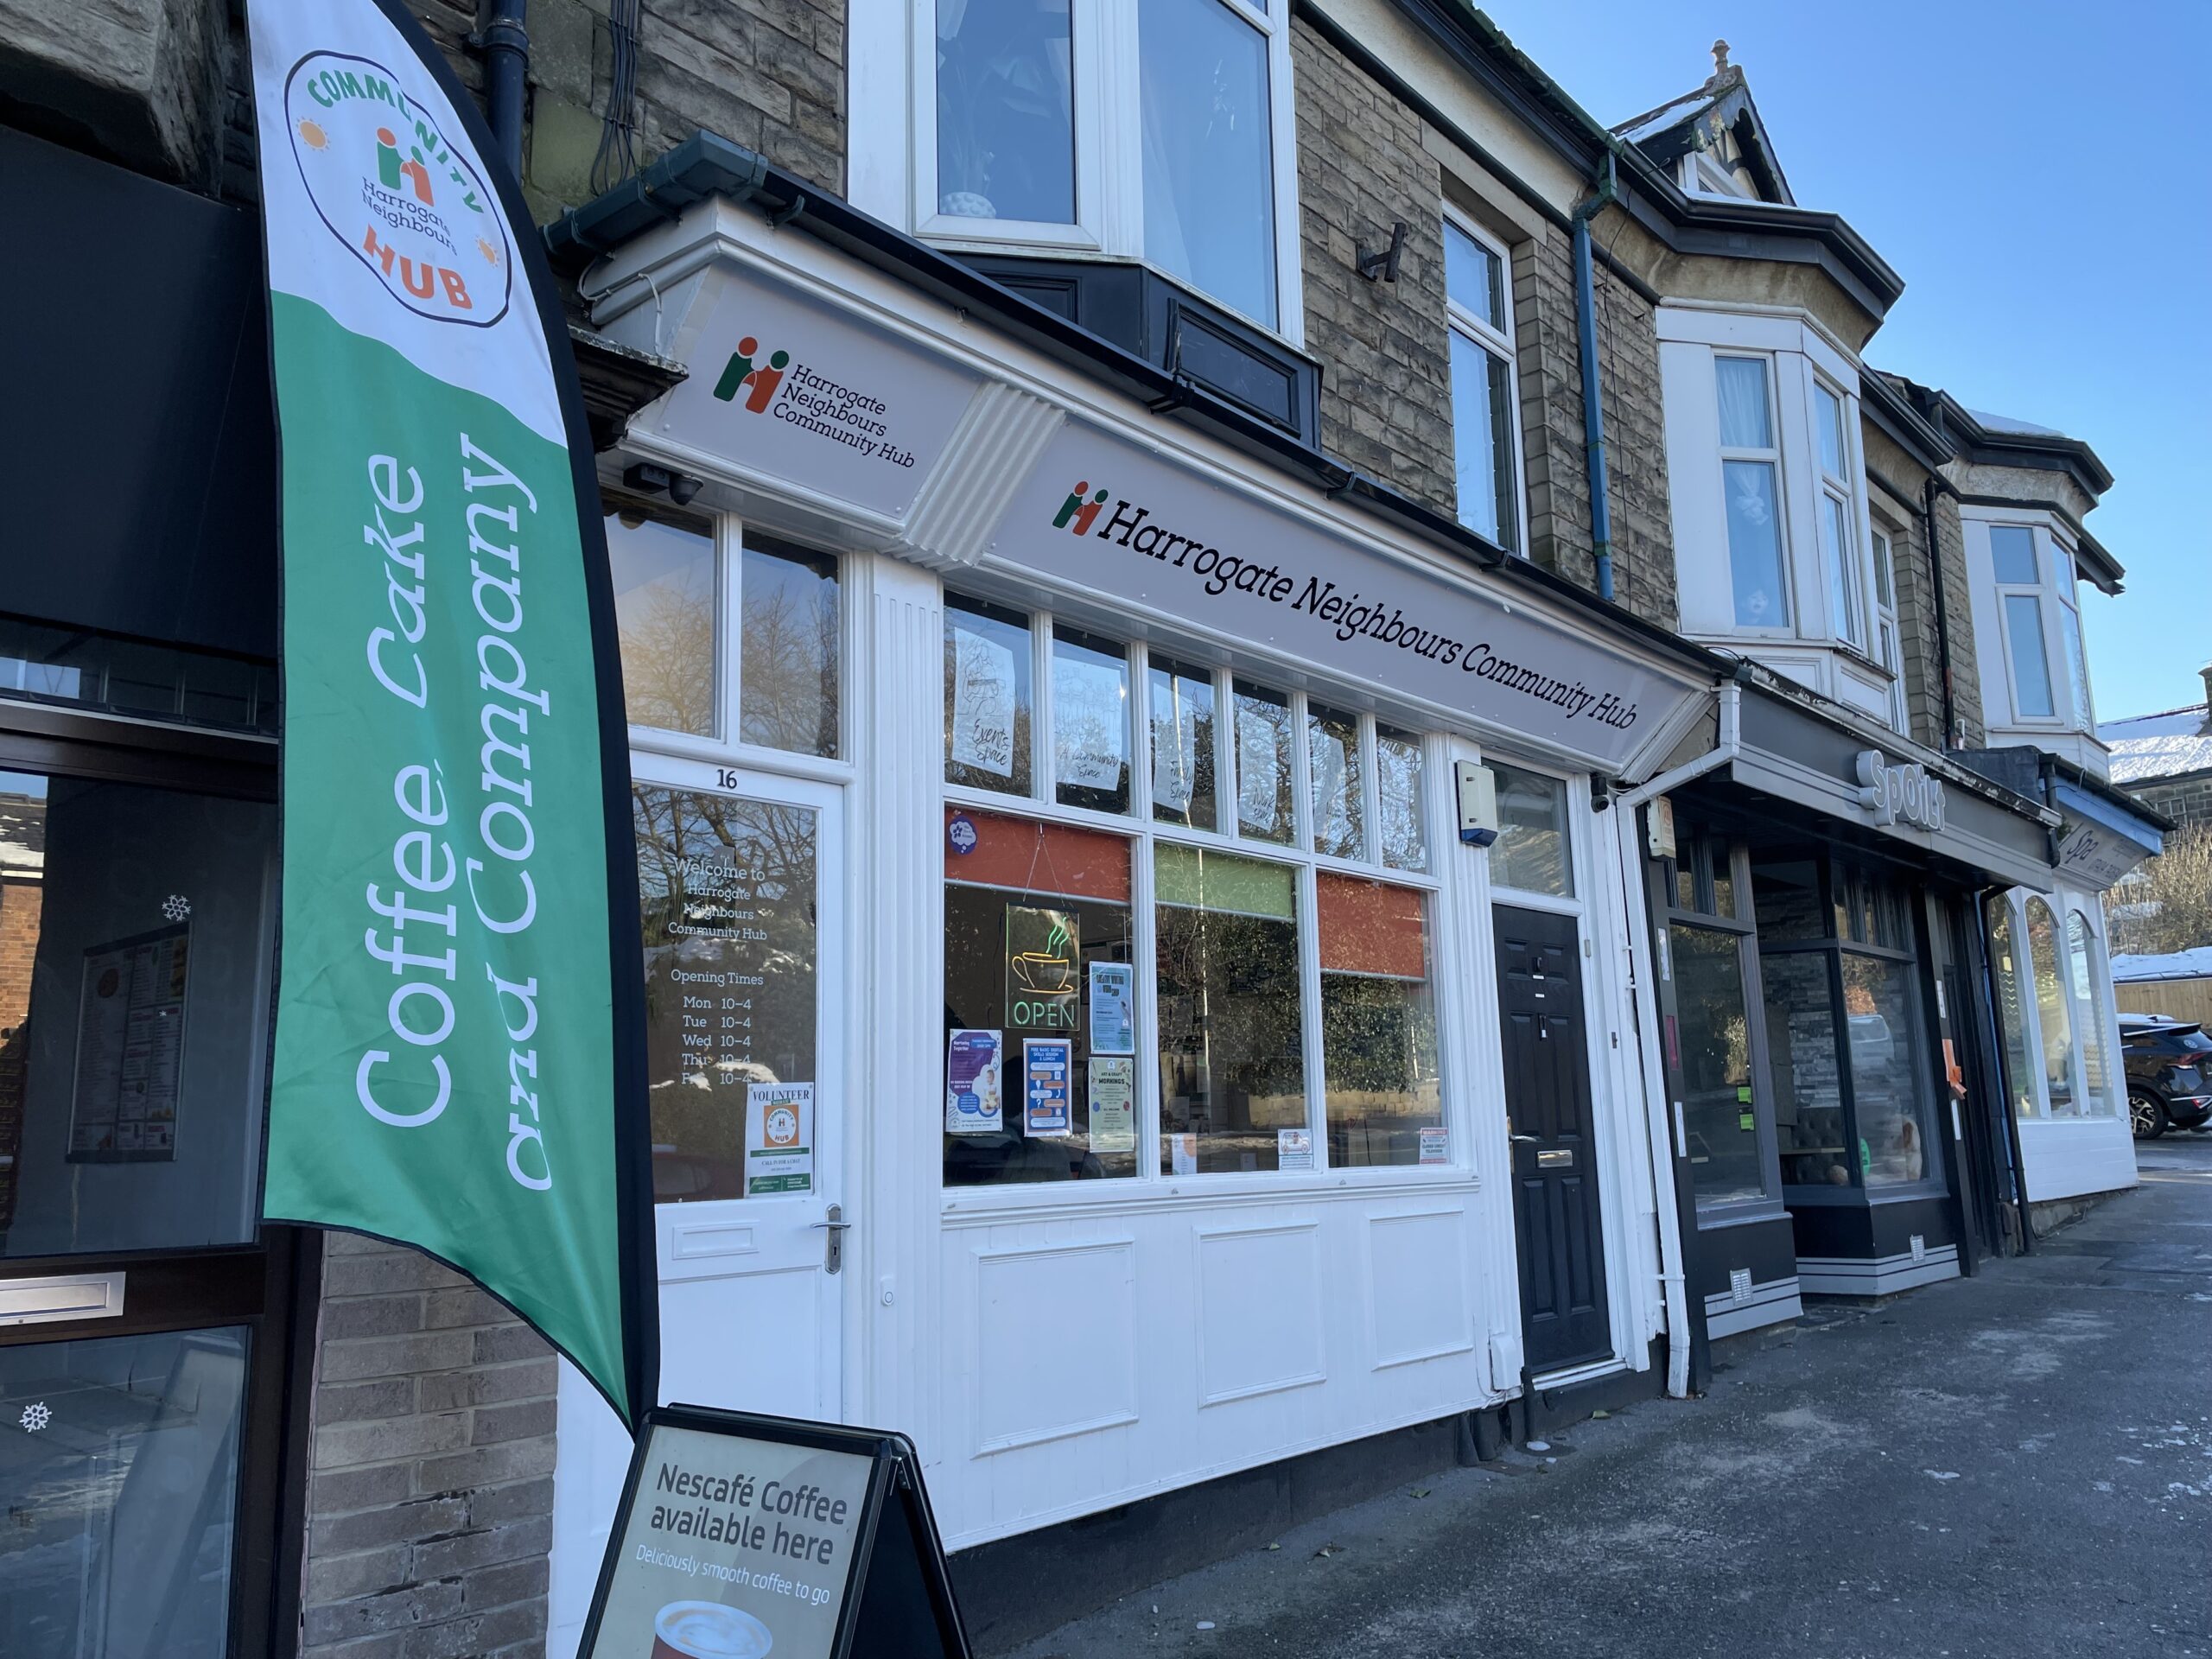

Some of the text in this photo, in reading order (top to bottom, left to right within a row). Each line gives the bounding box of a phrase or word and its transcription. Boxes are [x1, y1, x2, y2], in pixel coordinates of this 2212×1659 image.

[362, 177, 450, 236] Harrogate
[362, 191, 457, 256] Neighbours
[363, 223, 473, 309] HUB
[791, 364, 887, 416] Harrogate
[781, 383, 887, 436] Neighbours
[773, 403, 915, 468] Community Hub
[365, 453, 426, 709] Cake
[1096, 500, 1638, 729] Harrogate Neighbours Community Hub
[972, 718, 1010, 749] Events
[976, 742, 1007, 766] Space
[716, 769, 738, 789] 16
[460, 432, 551, 1192] and Company
[2064, 830, 2099, 864] Spa
[673, 857, 766, 881] Welcome to
[688, 884, 751, 902] Harrogate
[683, 904, 754, 920] Neighbours
[668, 921, 767, 940] Community Hub
[671, 969, 764, 987] Opening Times
[683, 996, 712, 1008] Mon
[1014, 1001, 1075, 1027] OPEN
[683, 1015, 707, 1027] Tue
[682, 1034, 712, 1046] Wed
[753, 1090, 810, 1102] VOLUNTEER
[657, 1462, 848, 1526] Nescafé Coffee
[650, 1504, 834, 1565] available here
[635, 1544, 830, 1607] Deliciously smooth coffee to go
